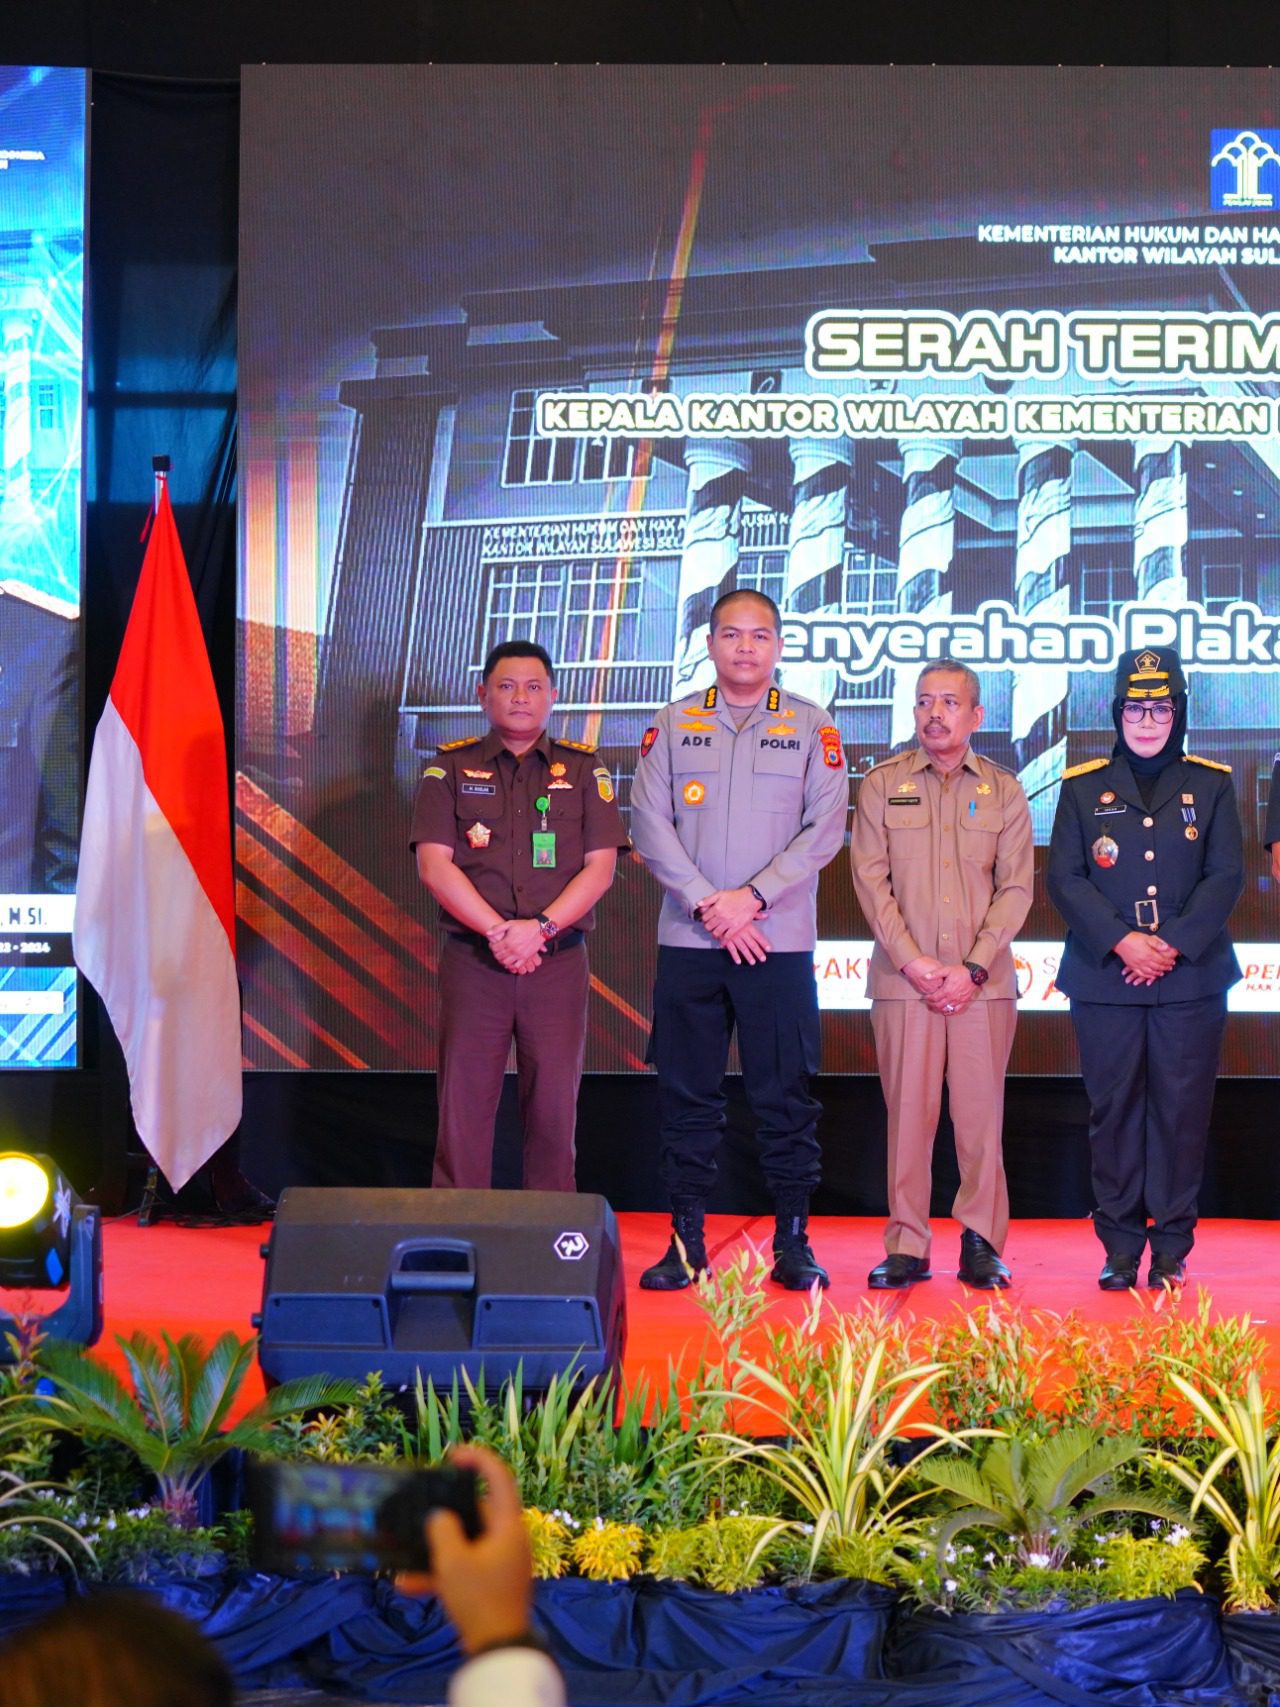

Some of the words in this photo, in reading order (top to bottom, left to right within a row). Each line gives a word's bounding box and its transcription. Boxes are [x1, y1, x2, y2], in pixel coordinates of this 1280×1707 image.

[978, 224, 1121, 243] KEMENTERIAN
[1124, 225, 1200, 243] HUKUM
[1204, 225, 1249, 244] DAN
[1053, 246, 1138, 264] KANTOR
[1141, 246, 1238, 265] WILAYAH
[814, 320, 1058, 370] SERAH
[542, 400, 683, 431] KEPALA
[690, 400, 838, 432] KANTOR
[845, 400, 1008, 433] WILAYAH
[1015, 401, 1270, 434] KEMENTERIAN
[781, 612, 1110, 672] enyerahan
[681, 735, 713, 748] ADE
[759, 738, 801, 751] POLRI
